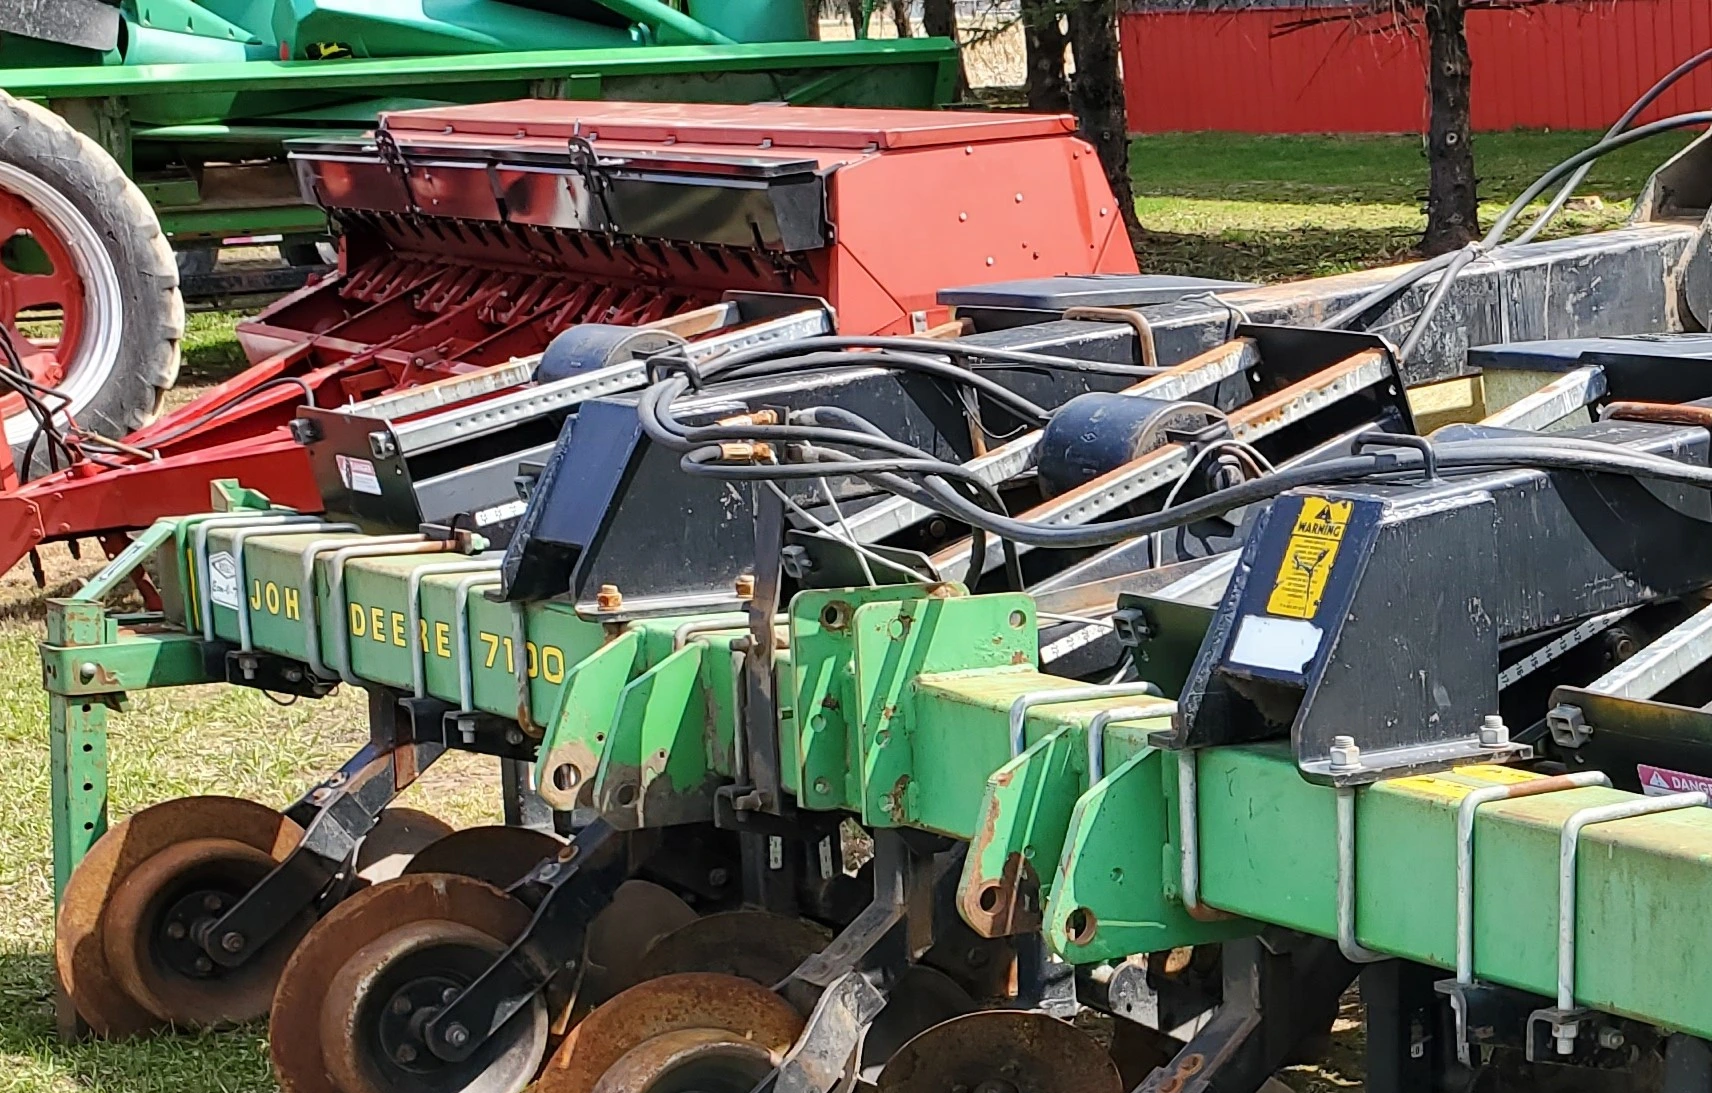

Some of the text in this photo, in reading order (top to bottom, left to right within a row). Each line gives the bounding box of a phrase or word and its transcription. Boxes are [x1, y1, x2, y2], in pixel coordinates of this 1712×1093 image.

[1298, 521, 1342, 537] WARNING
[250, 578, 565, 684] JOH DEERE 7100
